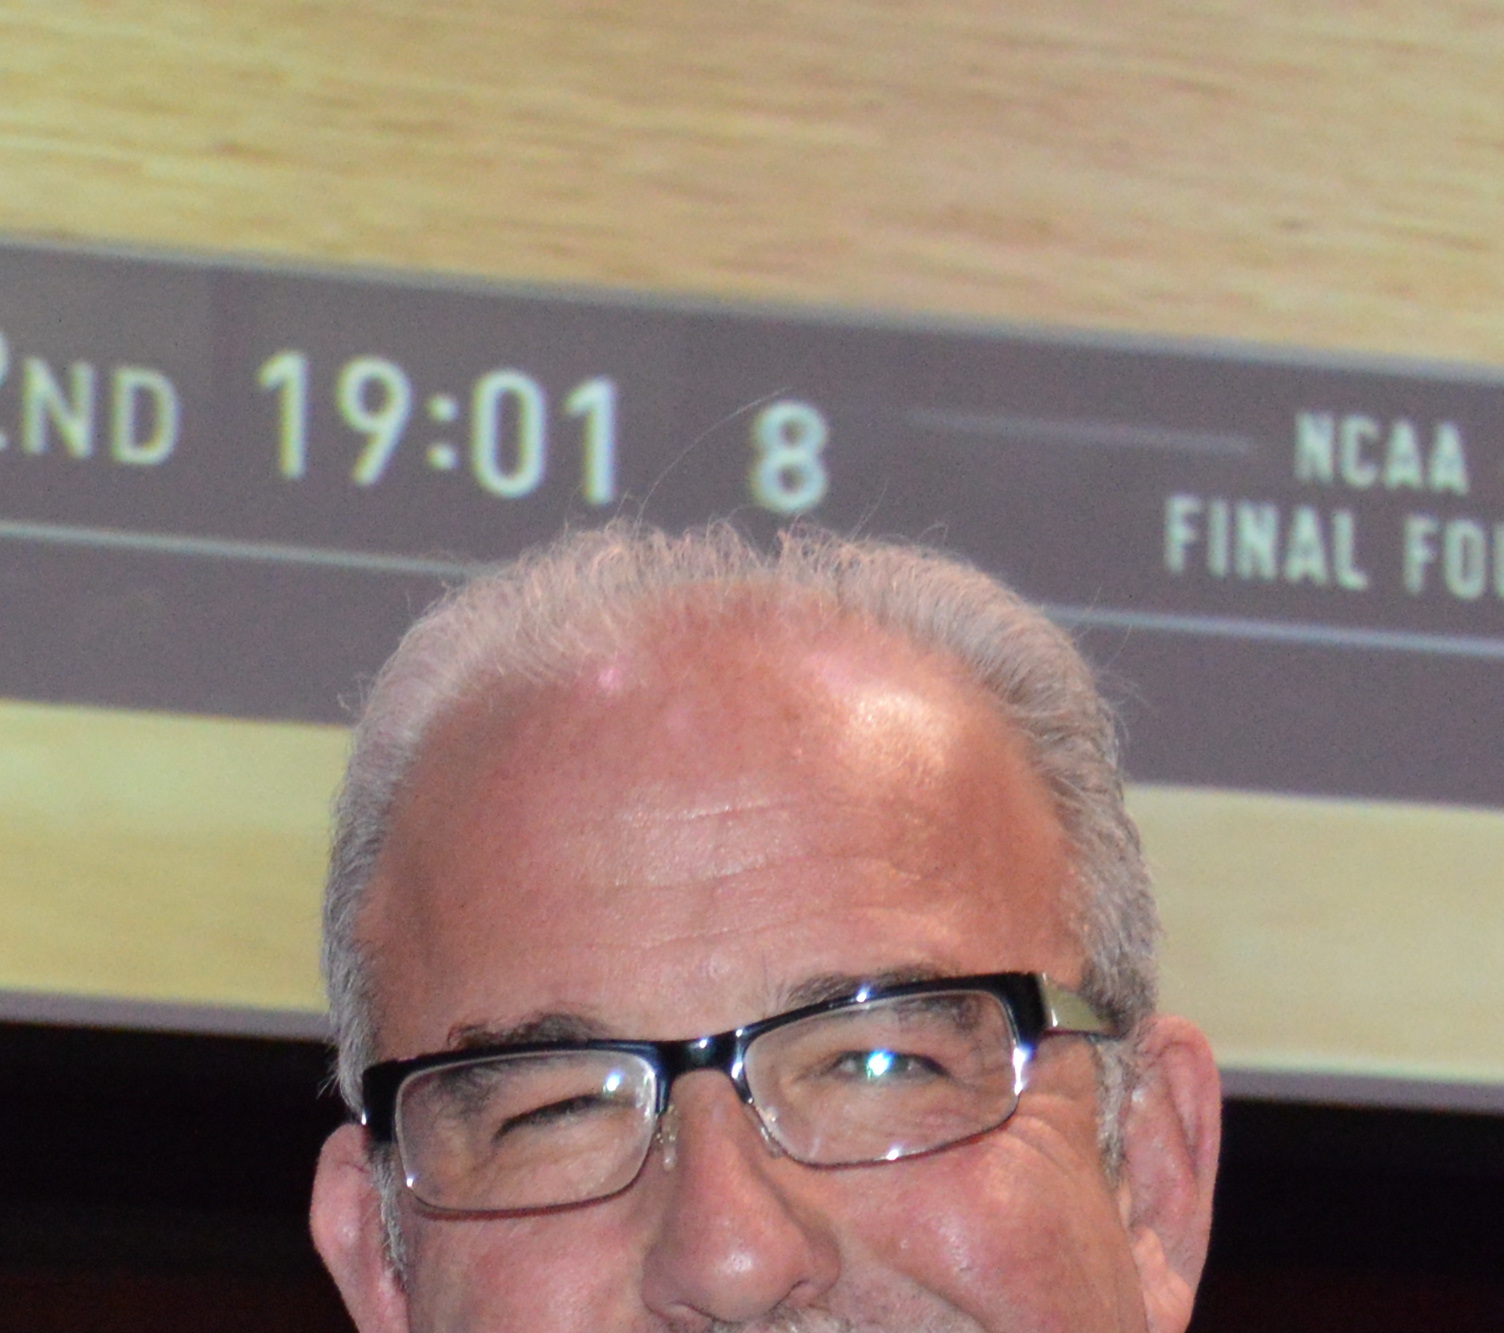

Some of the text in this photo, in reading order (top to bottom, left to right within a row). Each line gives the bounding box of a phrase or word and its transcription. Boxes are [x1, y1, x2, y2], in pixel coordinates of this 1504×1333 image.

[256, 348, 619, 507] 19:01
[751, 402, 831, 512] 8
[1294, 410, 1470, 496] NCAA
[1165, 494, 1369, 592] FINAL
